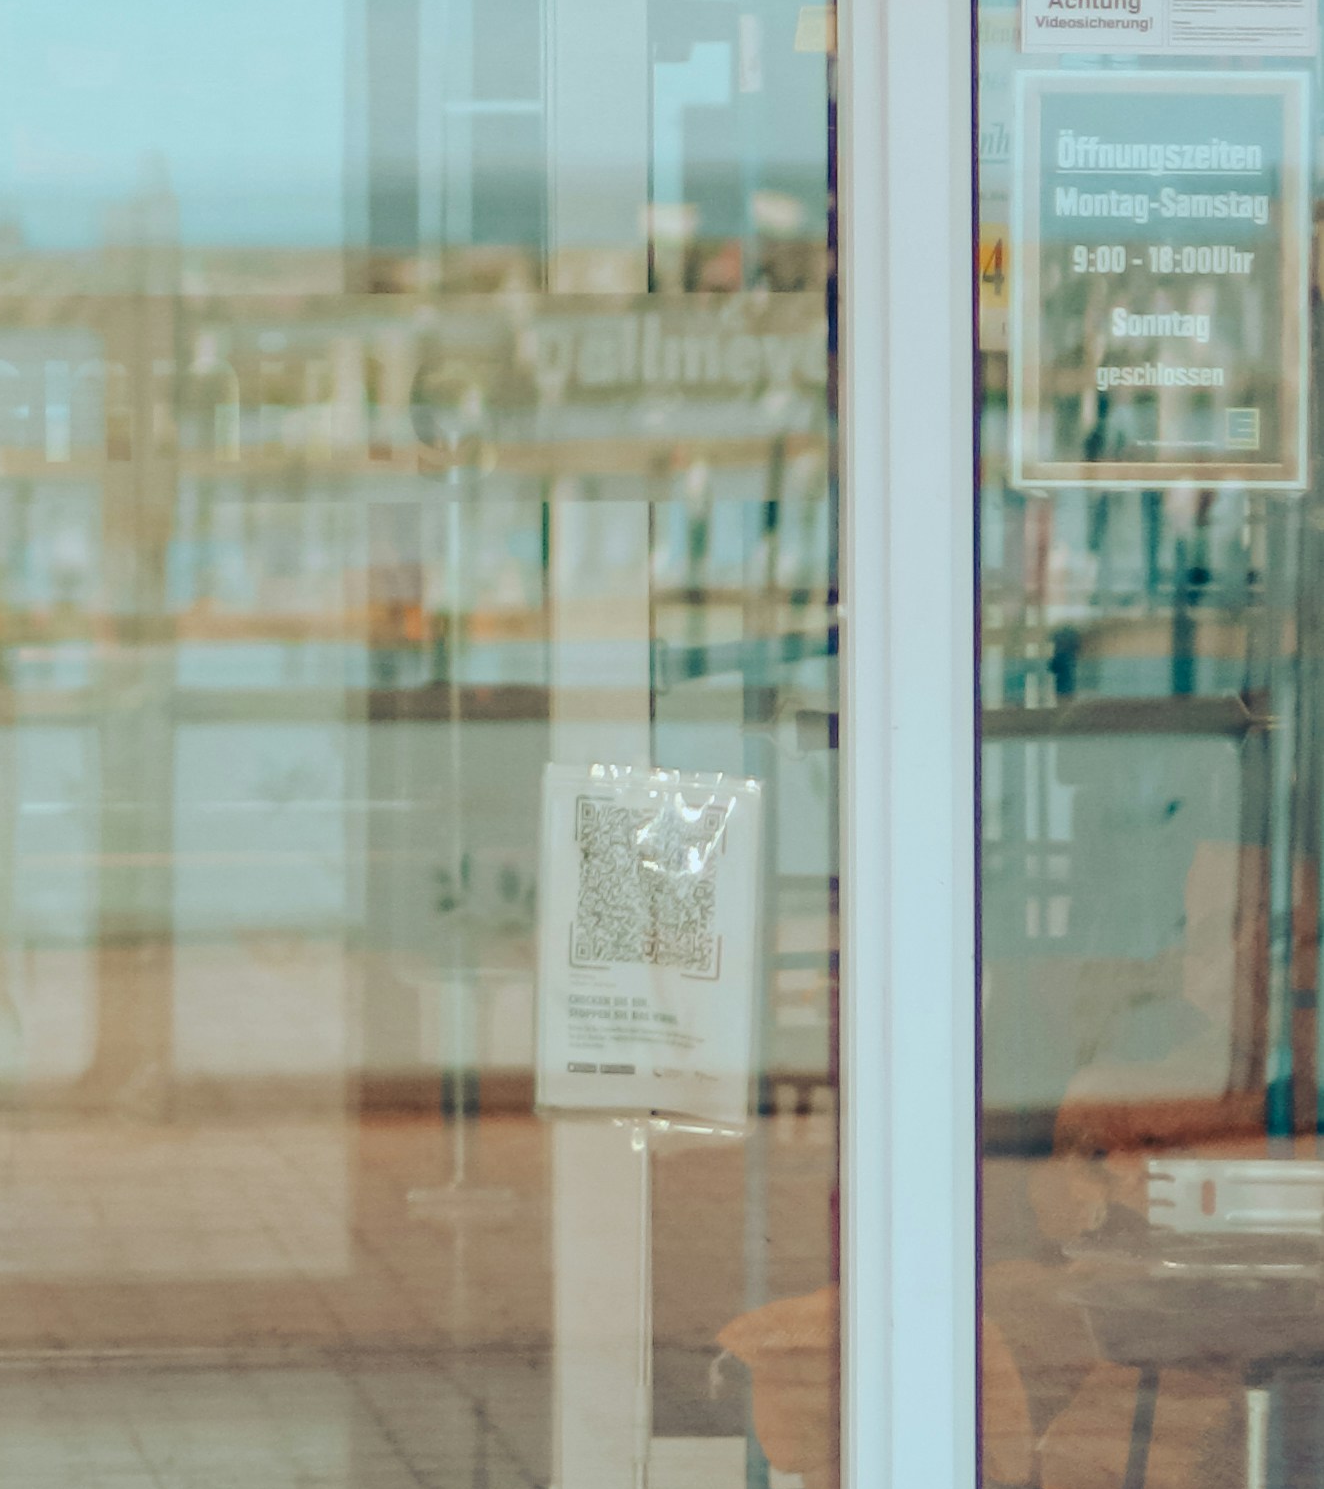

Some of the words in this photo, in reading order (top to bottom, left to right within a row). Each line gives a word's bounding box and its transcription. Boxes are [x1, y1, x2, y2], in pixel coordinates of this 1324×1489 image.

[1035, 15, 1154, 32] Videosicherung!
[1057, 129, 1262, 175] Öffnungszeiten
[1056, 186, 1269, 224] Montag-Samstag
[1073, 245, 1126, 273] 9:00
[1111, 307, 1210, 343] Sonntag
[1096, 362, 1224, 392] geschlossen
